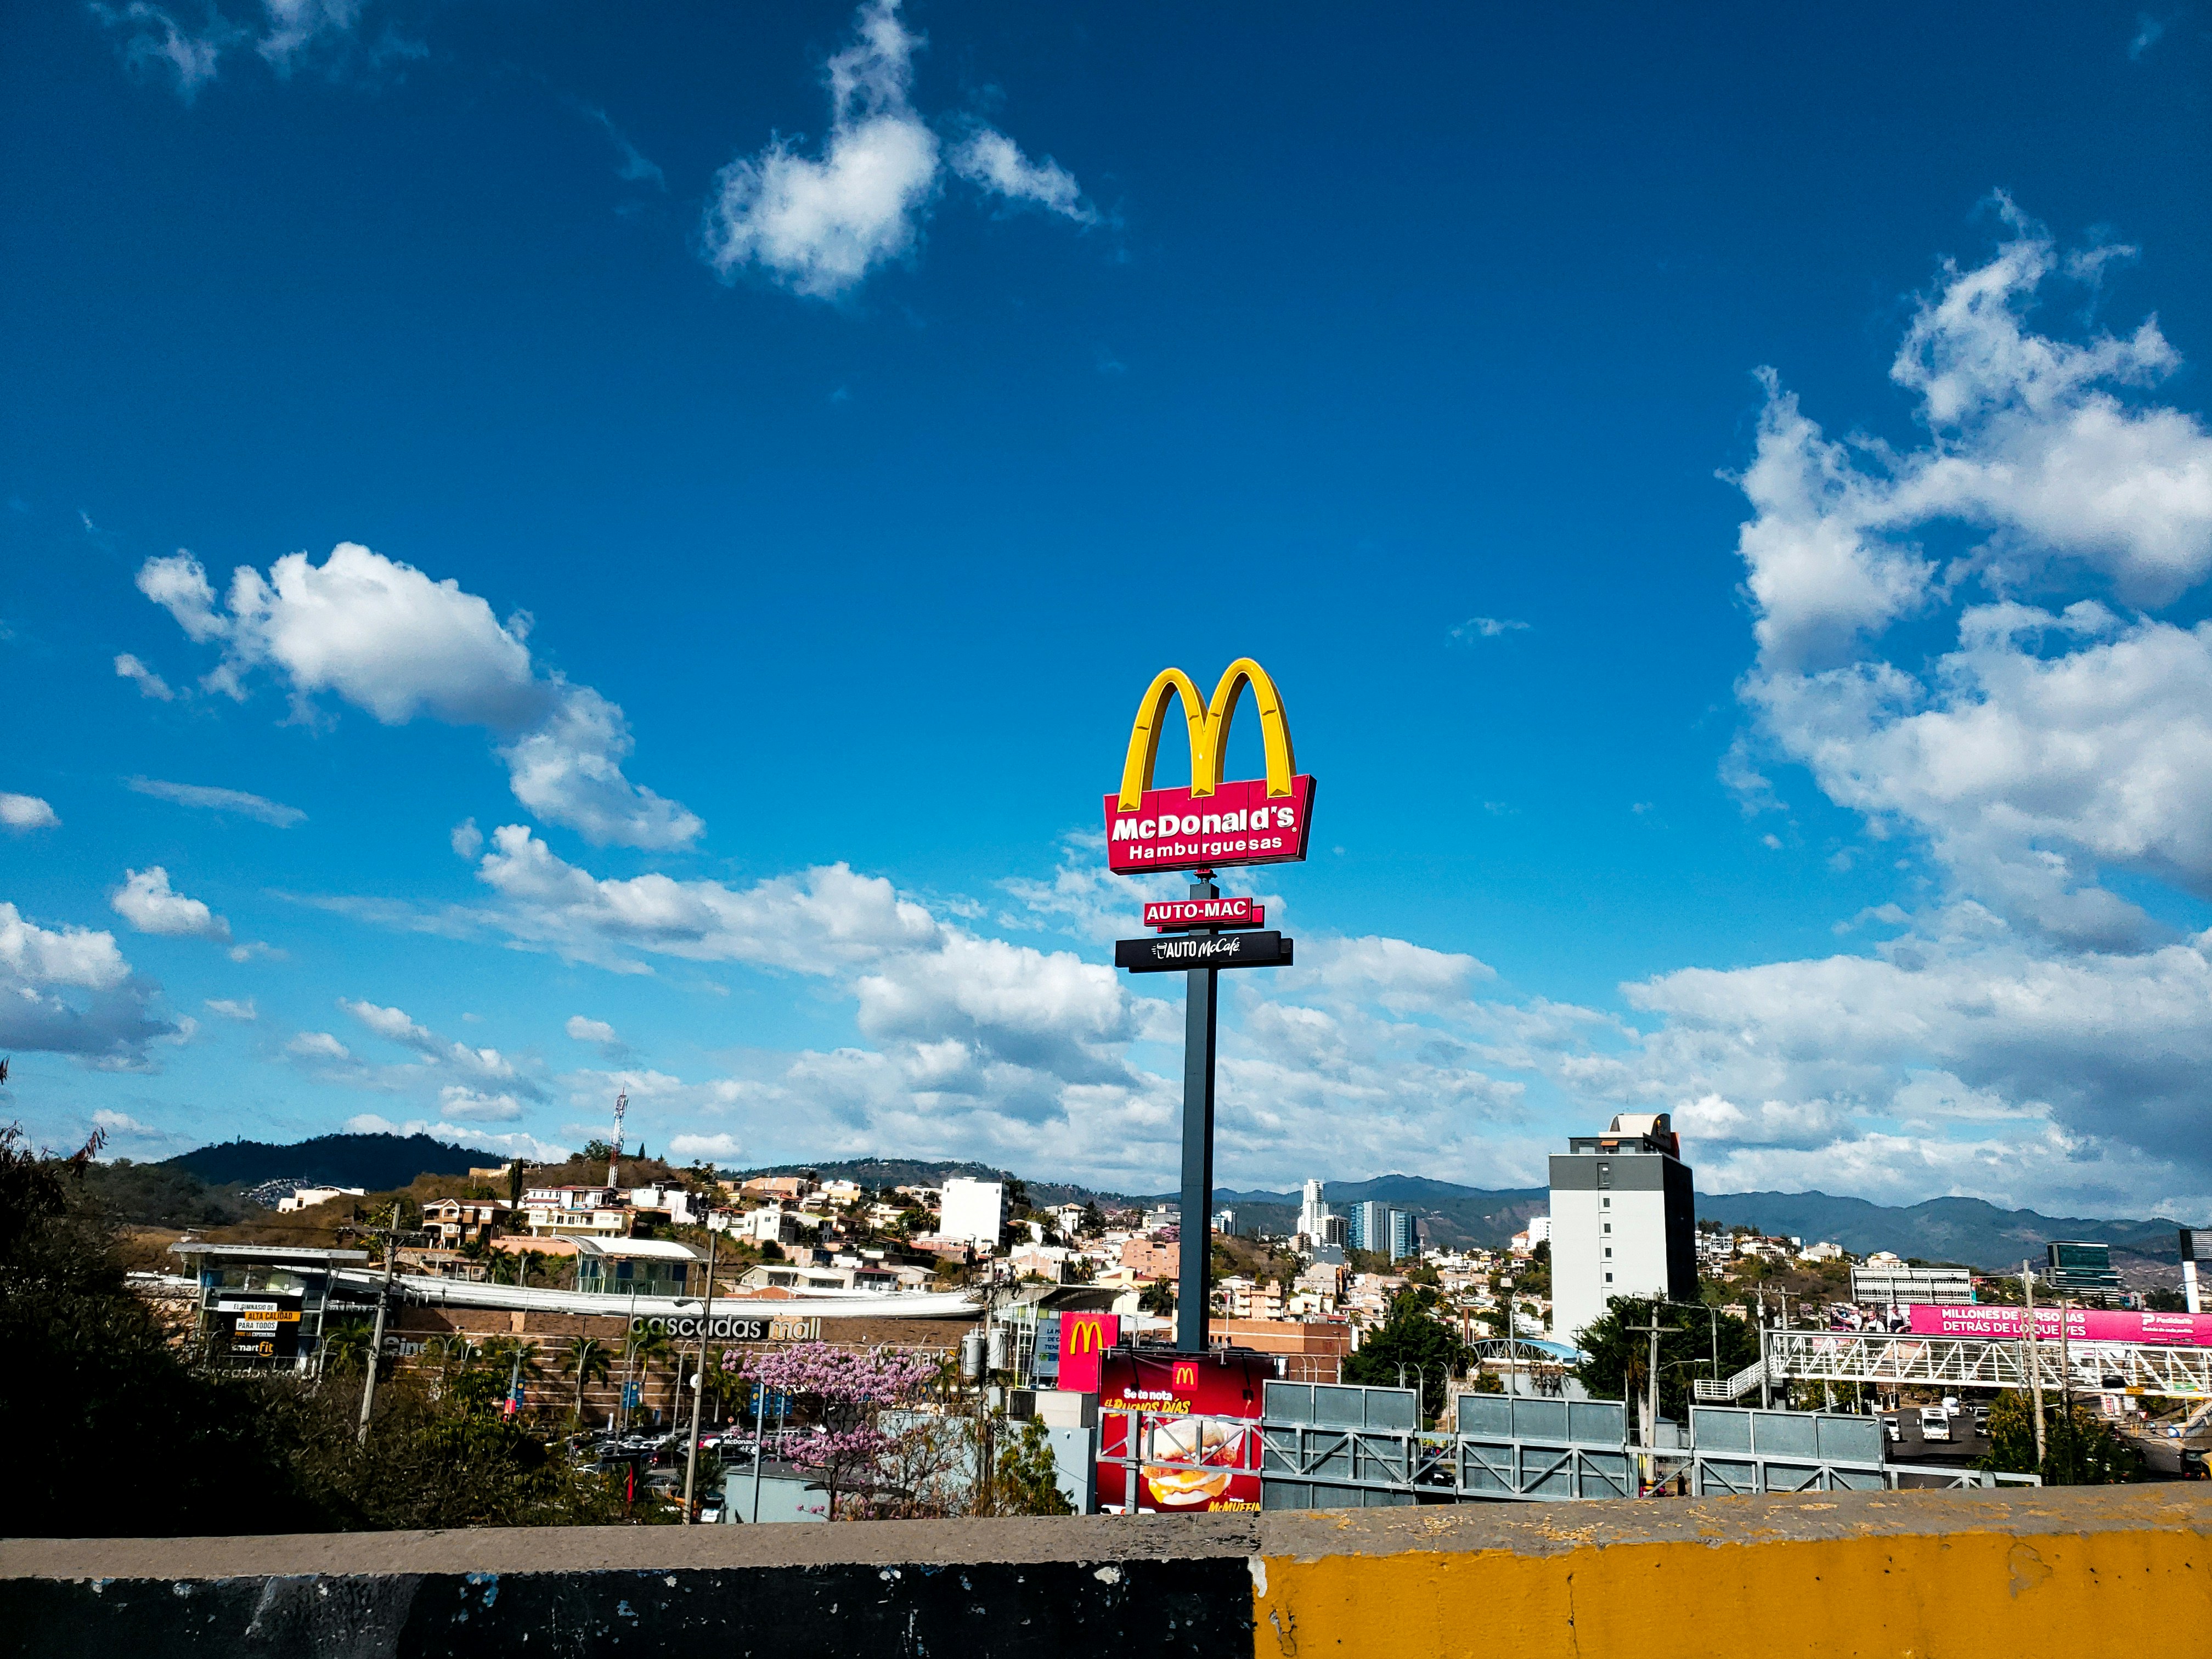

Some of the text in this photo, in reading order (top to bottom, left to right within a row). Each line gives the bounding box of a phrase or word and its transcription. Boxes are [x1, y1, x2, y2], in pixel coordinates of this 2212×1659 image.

[1111, 806, 1295, 842] McDonald's
[1129, 837, 1283, 860] Hamburguesas
[1147, 901, 1246, 921] AUTO-MAC
[1166, 936, 1240, 958] AUTO McCafé
[248, 1312, 293, 1320] ALTA CALIDAD
[1942, 1309, 2000, 1320] MILLONES
[2003, 1311, 2019, 1321] DE
[769, 1317, 821, 1340] mall
[1943, 1320, 1991, 1332] DETRÁS
[1994, 1323, 2011, 1333] DE
[1124, 1388, 1173, 1401] Se te nota
